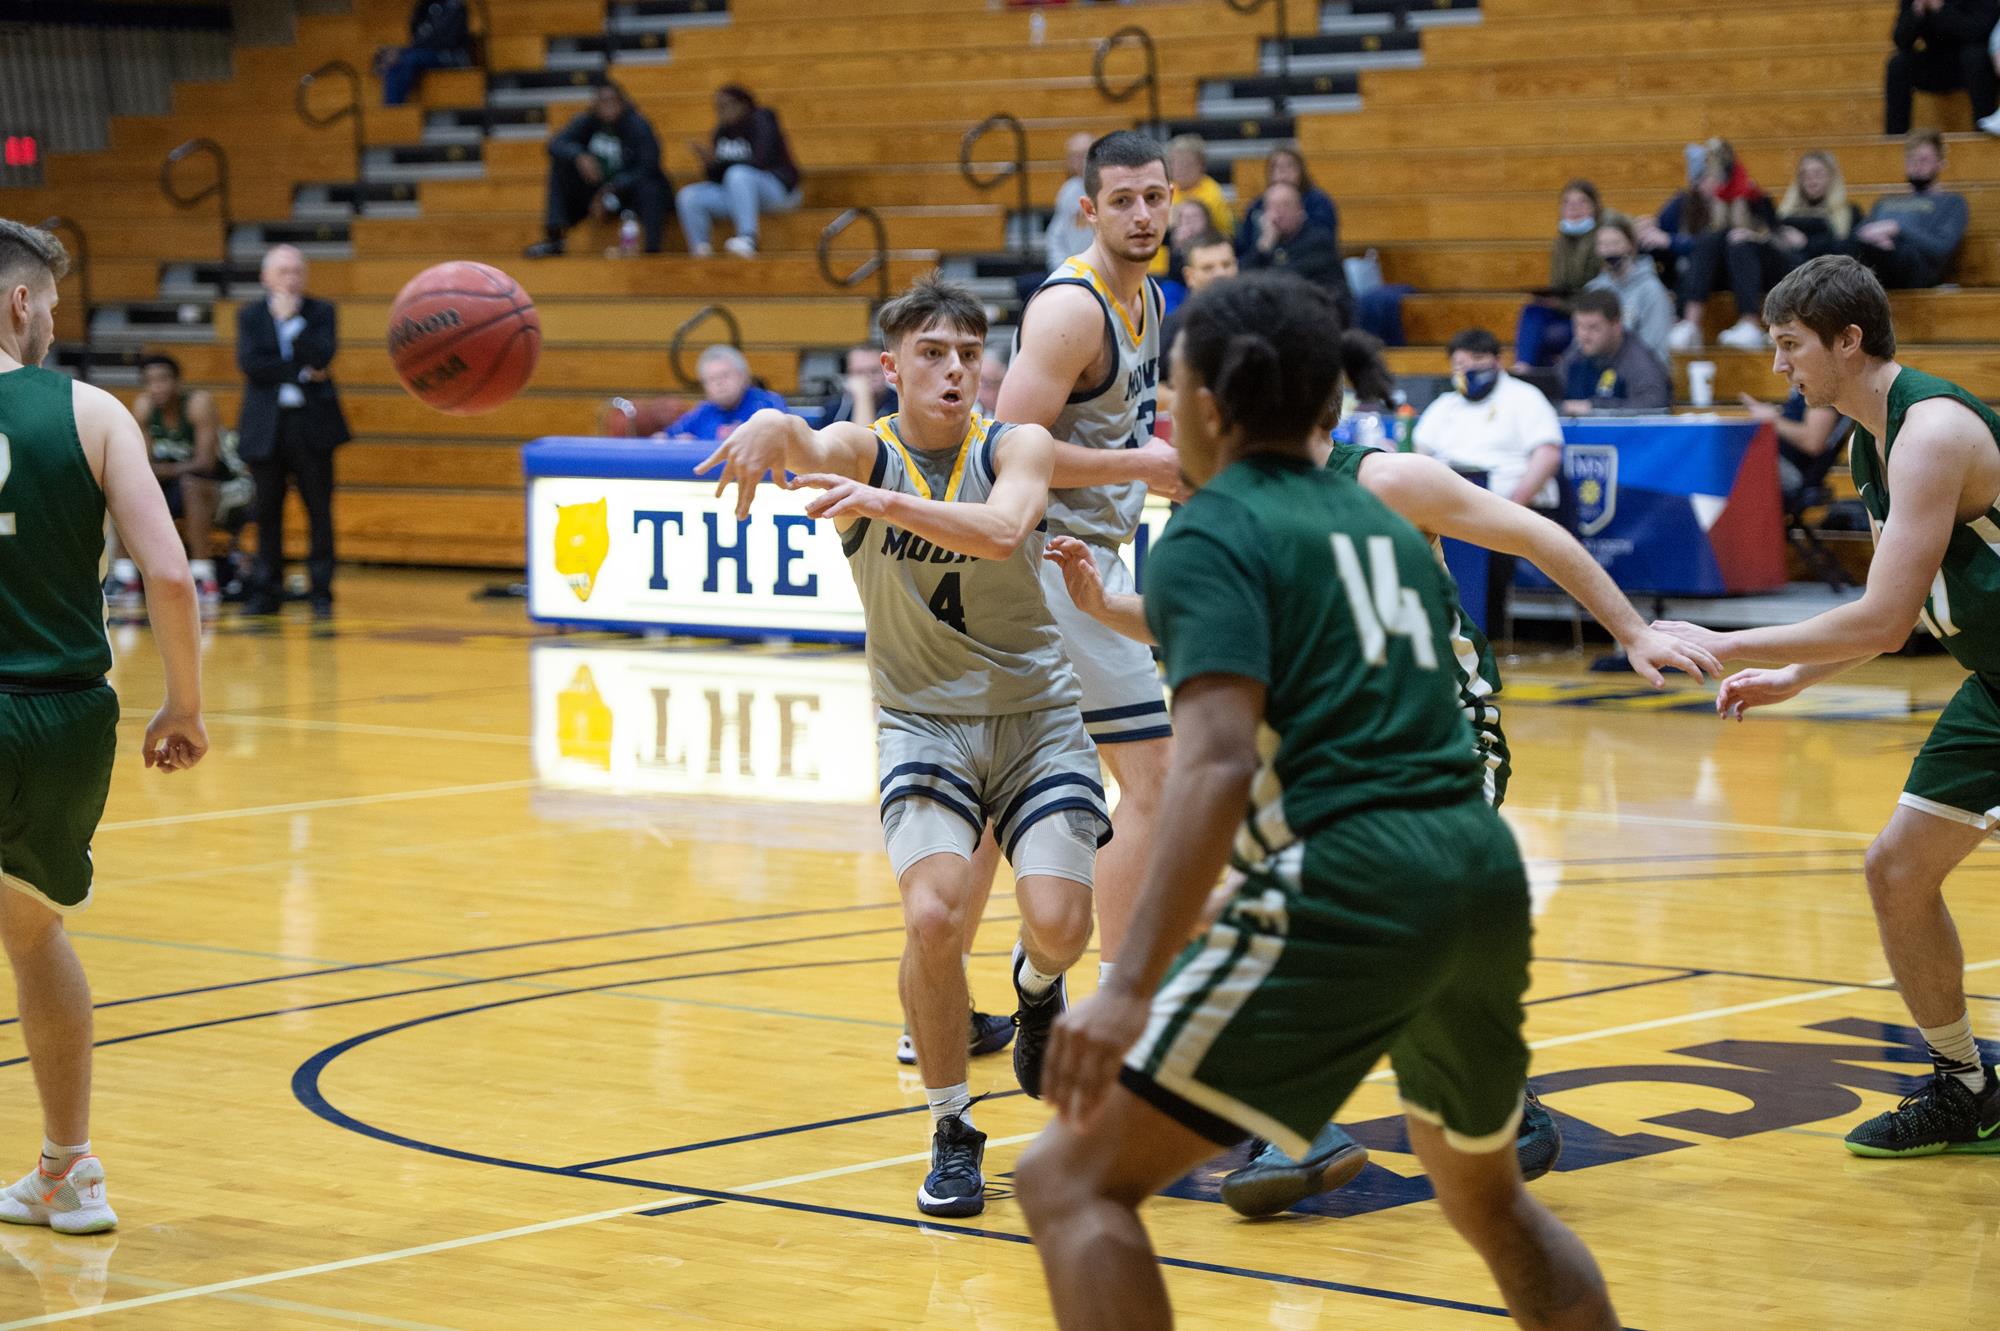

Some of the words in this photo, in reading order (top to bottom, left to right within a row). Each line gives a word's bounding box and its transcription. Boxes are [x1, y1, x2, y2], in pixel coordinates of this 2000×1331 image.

[633, 510, 818, 597] THE
[881, 526, 980, 563] MOU
[928, 570, 967, 635] 4
[1329, 531, 1439, 671] 14
